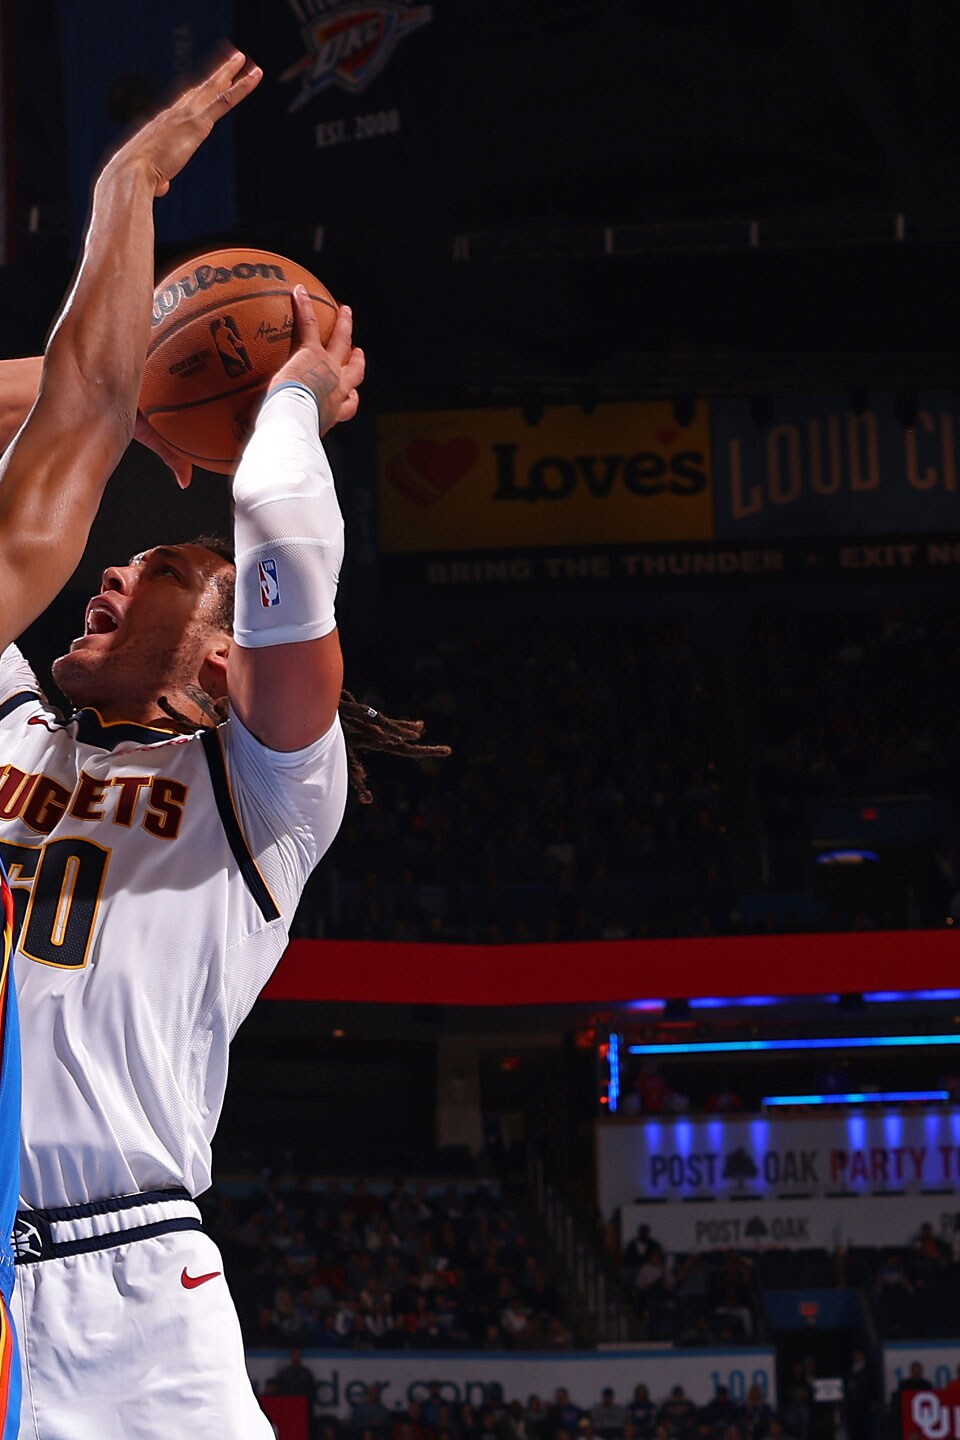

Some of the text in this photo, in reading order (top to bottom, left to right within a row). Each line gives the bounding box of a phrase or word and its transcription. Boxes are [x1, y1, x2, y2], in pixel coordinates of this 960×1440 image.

[729, 410, 880, 521] LOUD
[427, 560, 532, 585] BRING
[543, 556, 611, 579] THE
[621, 550, 785, 577] THUNDER
[841, 544, 917, 569] EXIT
[651, 1153, 718, 1188] POST
[764, 1150, 819, 1185] OAK
[830, 1146, 927, 1182] PARTY
[695, 1216, 810, 1243] POST OAK
